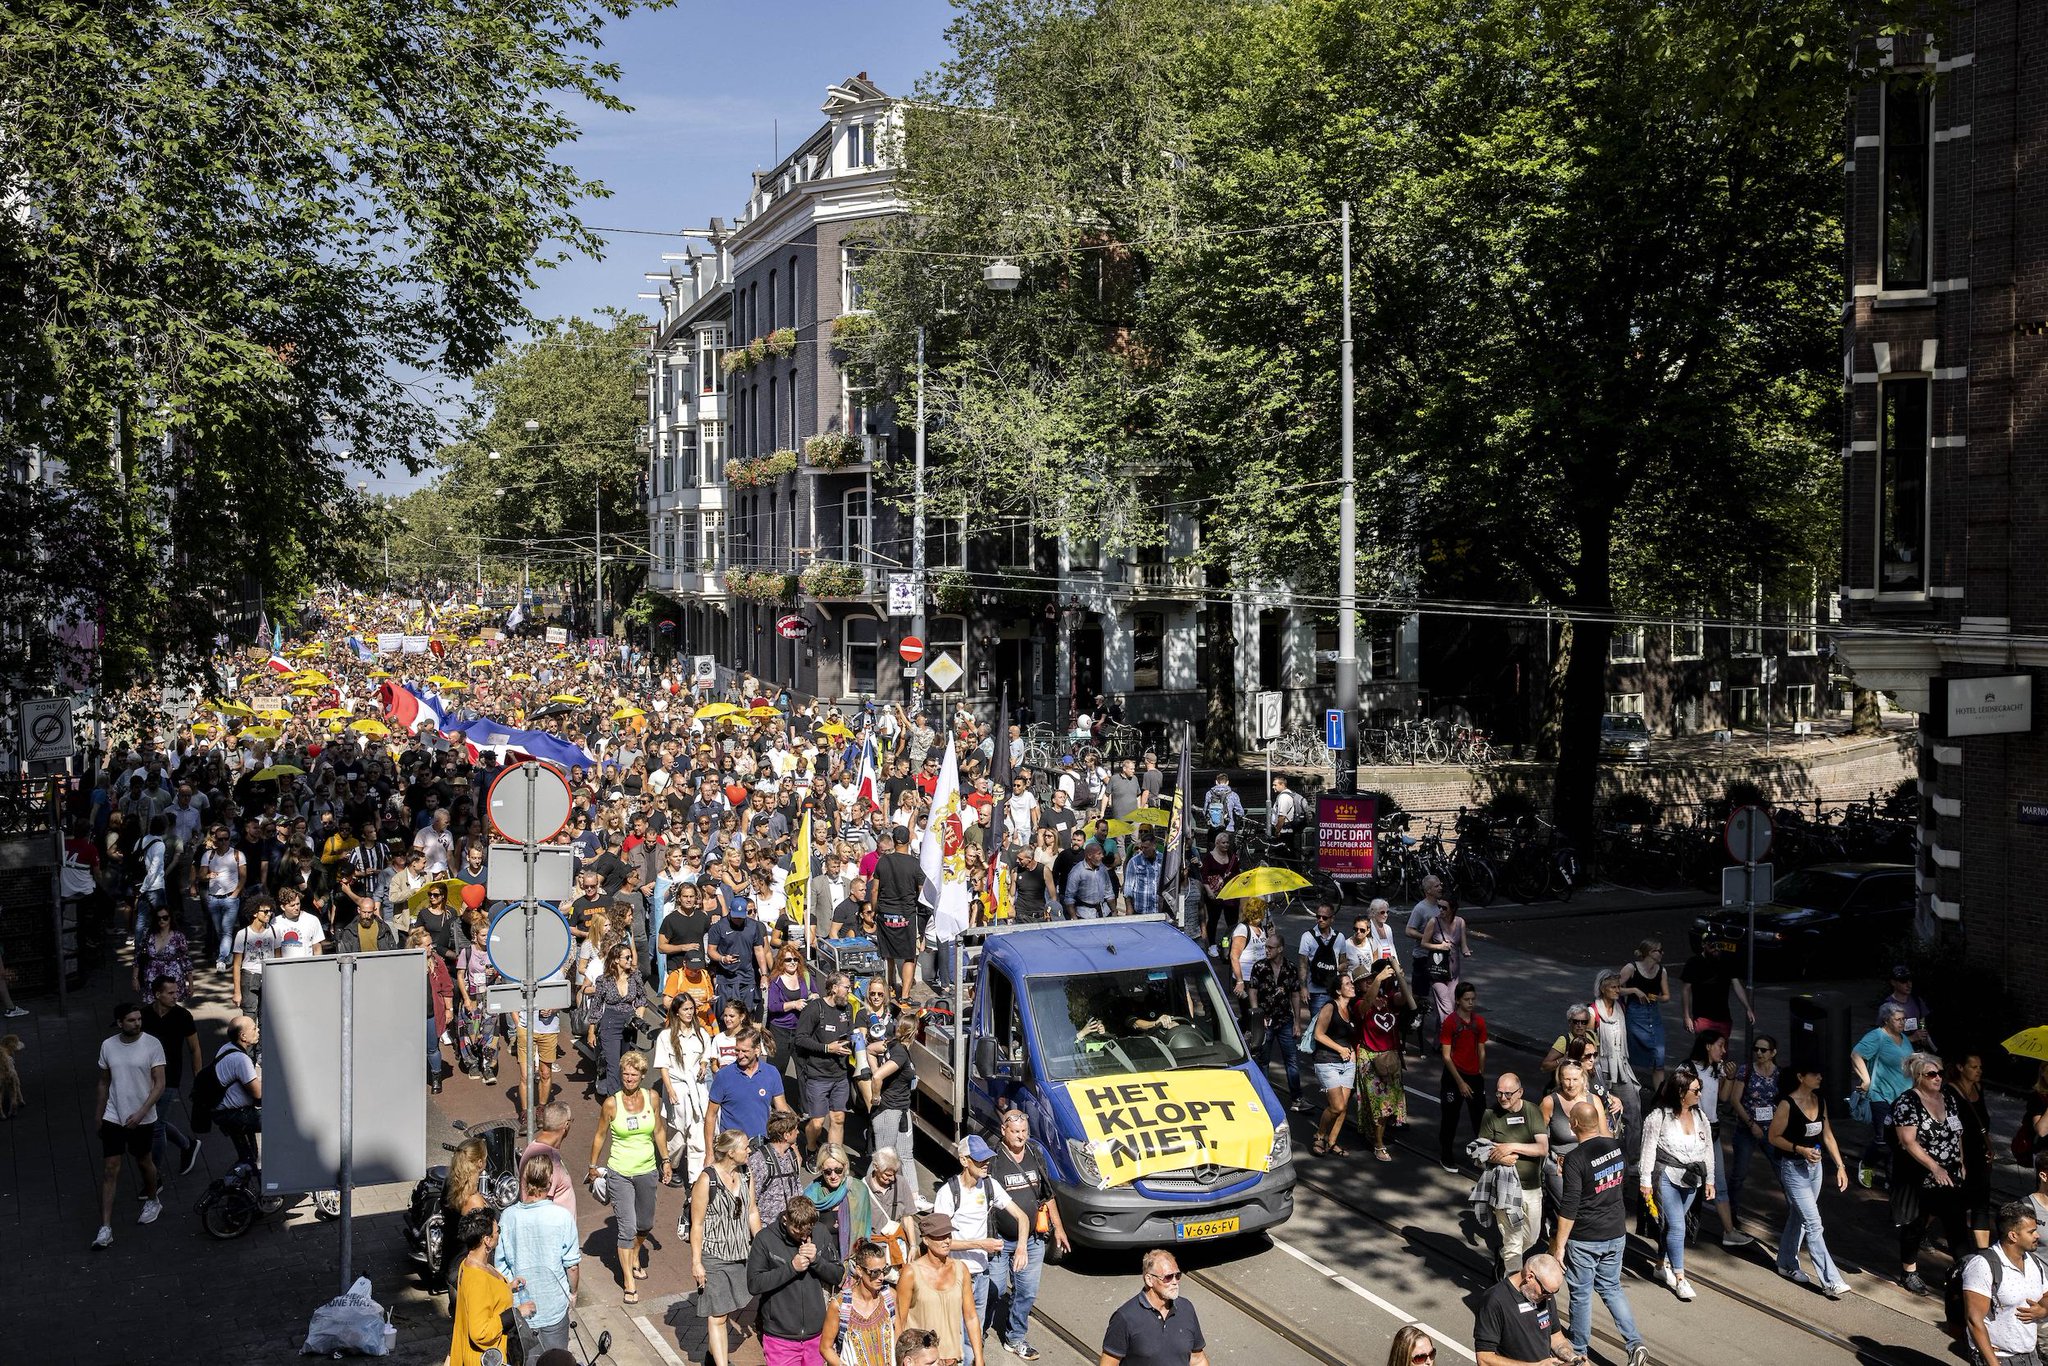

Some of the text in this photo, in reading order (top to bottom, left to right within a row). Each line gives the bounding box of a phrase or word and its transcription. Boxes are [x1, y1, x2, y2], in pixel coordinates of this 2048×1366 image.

[783, 627, 808, 637] Hotel
[1955, 704, 2024, 715] HOTEL LEIDSEGRACHT
[1319, 829, 1372, 840] OP DE DAM
[1319, 848, 1373, 857] OPENING NIGHT
[1085, 1081, 1169, 1109] HET
[1096, 1101, 1236, 1135] KLOPT
[1106, 1125, 1218, 1169] NIET.
[1591, 1147, 1622, 1168] ORDETEAM
[1185, 1221, 1234, 1237] V-696-FV
